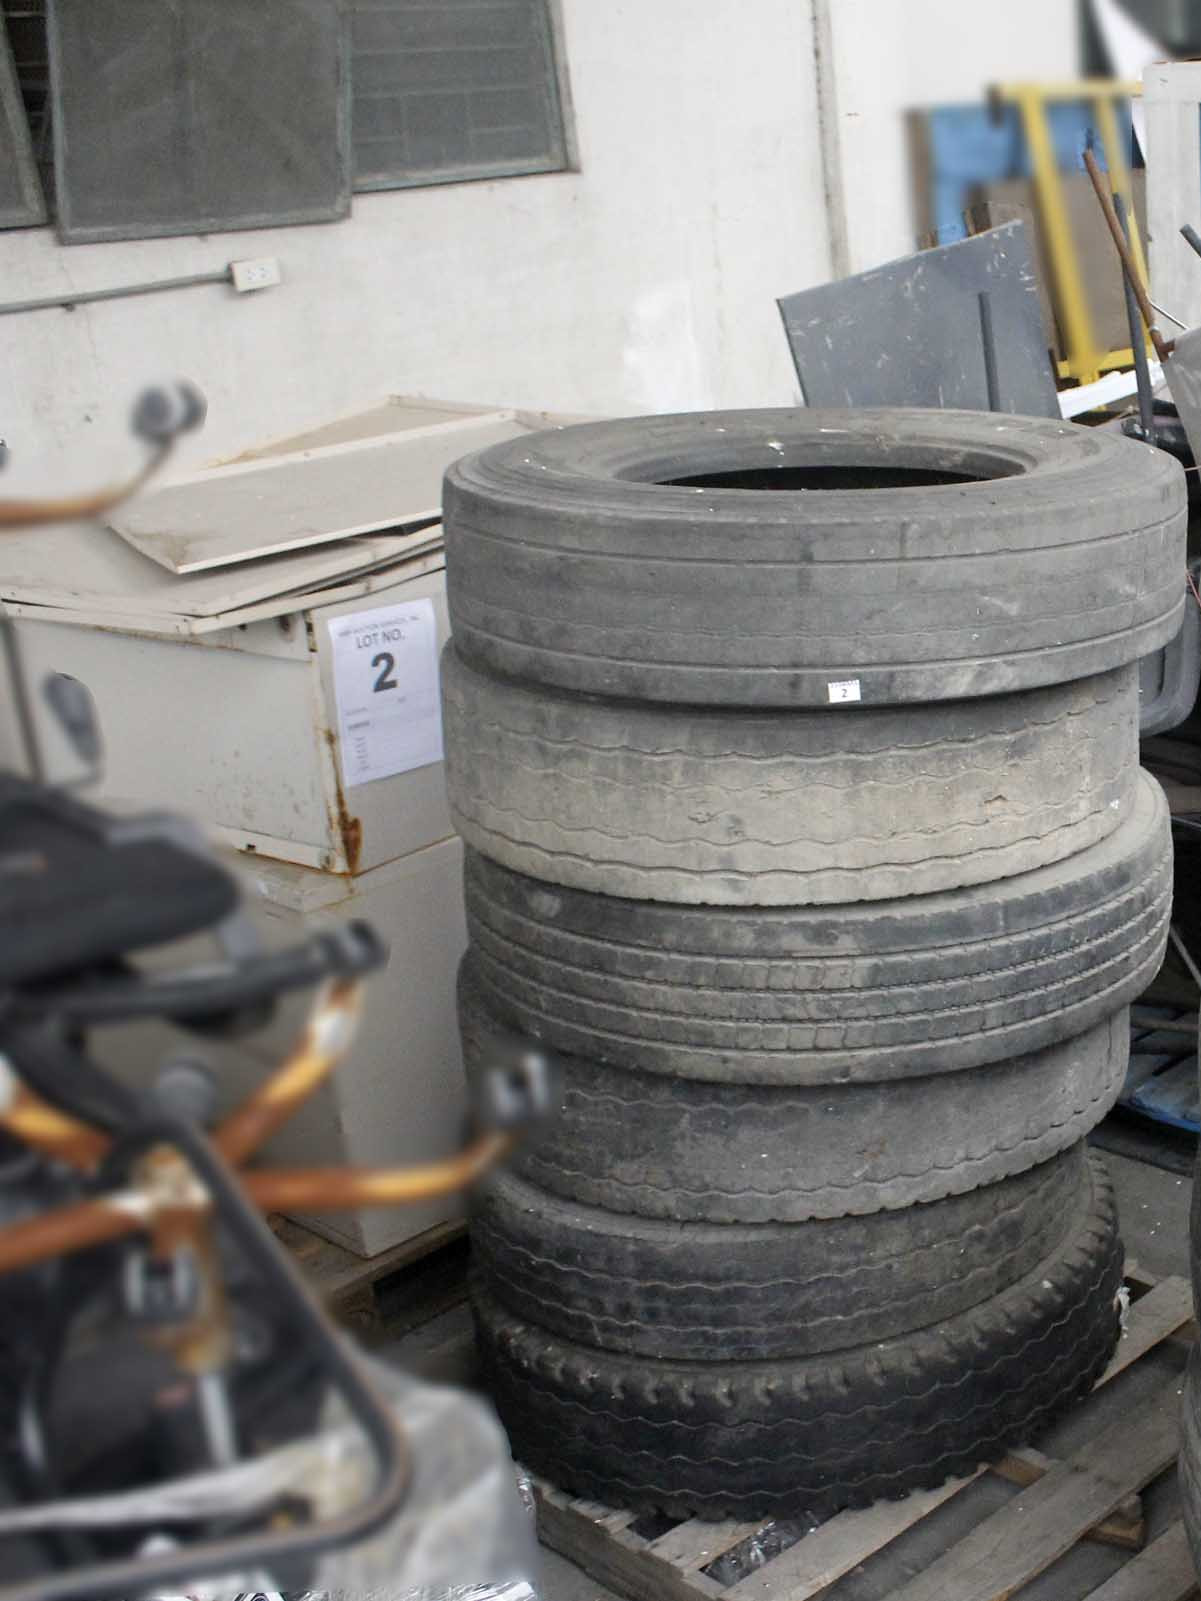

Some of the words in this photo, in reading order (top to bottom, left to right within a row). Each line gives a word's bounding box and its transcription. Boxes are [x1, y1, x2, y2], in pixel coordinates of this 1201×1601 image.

[355, 632, 379, 649] LOT
[382, 628, 406, 645] NO.
[371, 652, 398, 694] 2
[841, 688, 848, 698] 2
